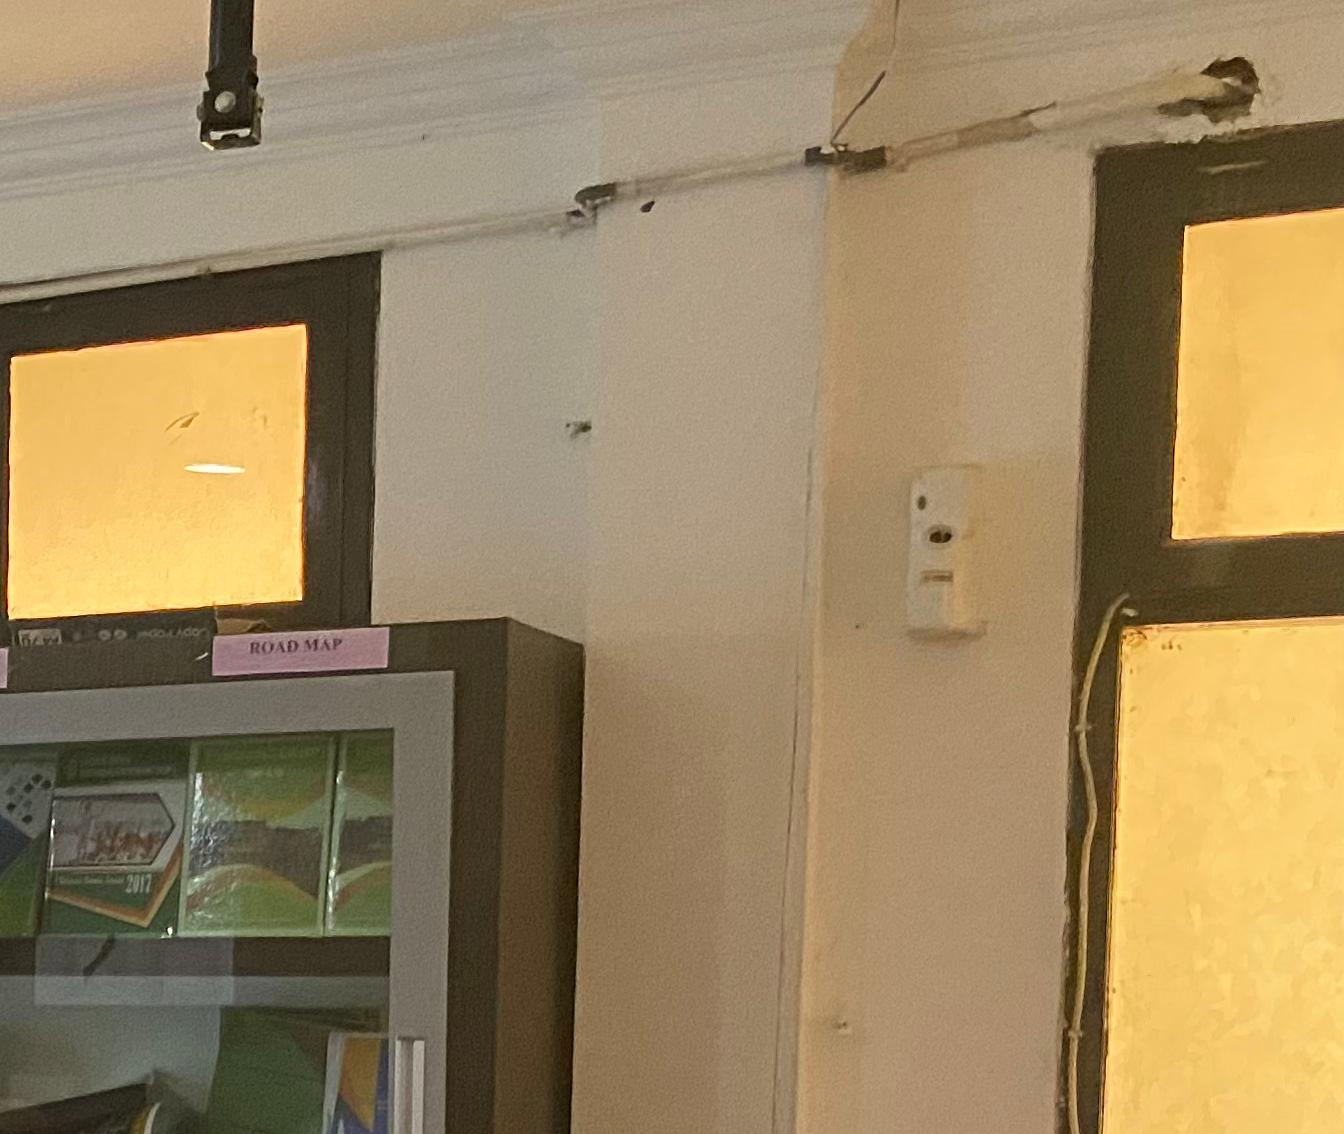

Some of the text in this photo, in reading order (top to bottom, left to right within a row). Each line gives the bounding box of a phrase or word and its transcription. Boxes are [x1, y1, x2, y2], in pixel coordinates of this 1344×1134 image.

[249, 637, 343, 656] ROAD MAP
[125, 875, 152, 894] 2017
